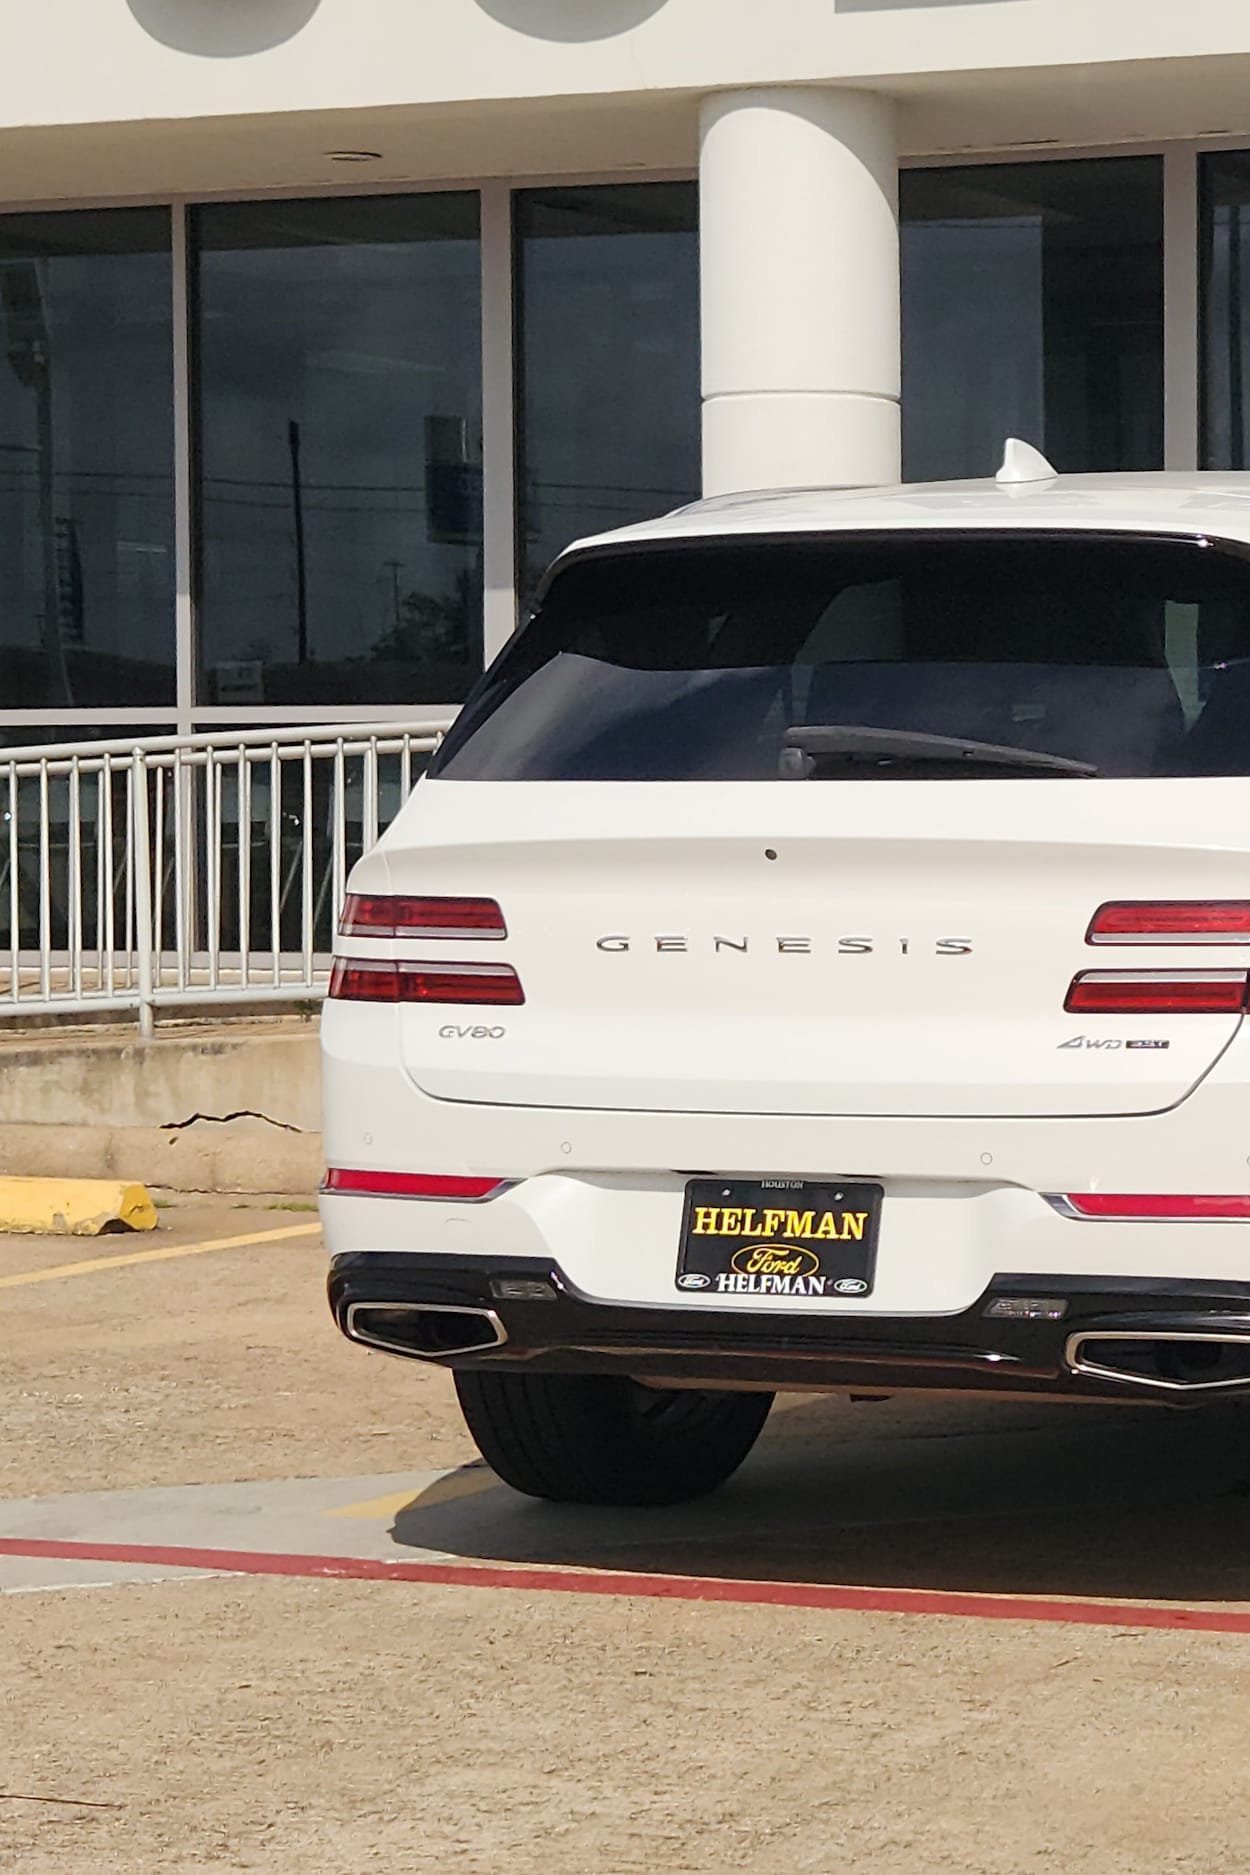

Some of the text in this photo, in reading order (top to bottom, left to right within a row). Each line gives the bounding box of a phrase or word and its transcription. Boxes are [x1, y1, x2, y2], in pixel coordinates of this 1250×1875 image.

[596, 935, 974, 955] GENESIS
[438, 1025, 506, 1039] GV80
[1056, 1035, 1122, 1049] AWD
[692, 1207, 868, 1240] HELFMAN
[746, 1247, 802, 1275] Ford
[716, 1273, 826, 1294] HELFMAN
